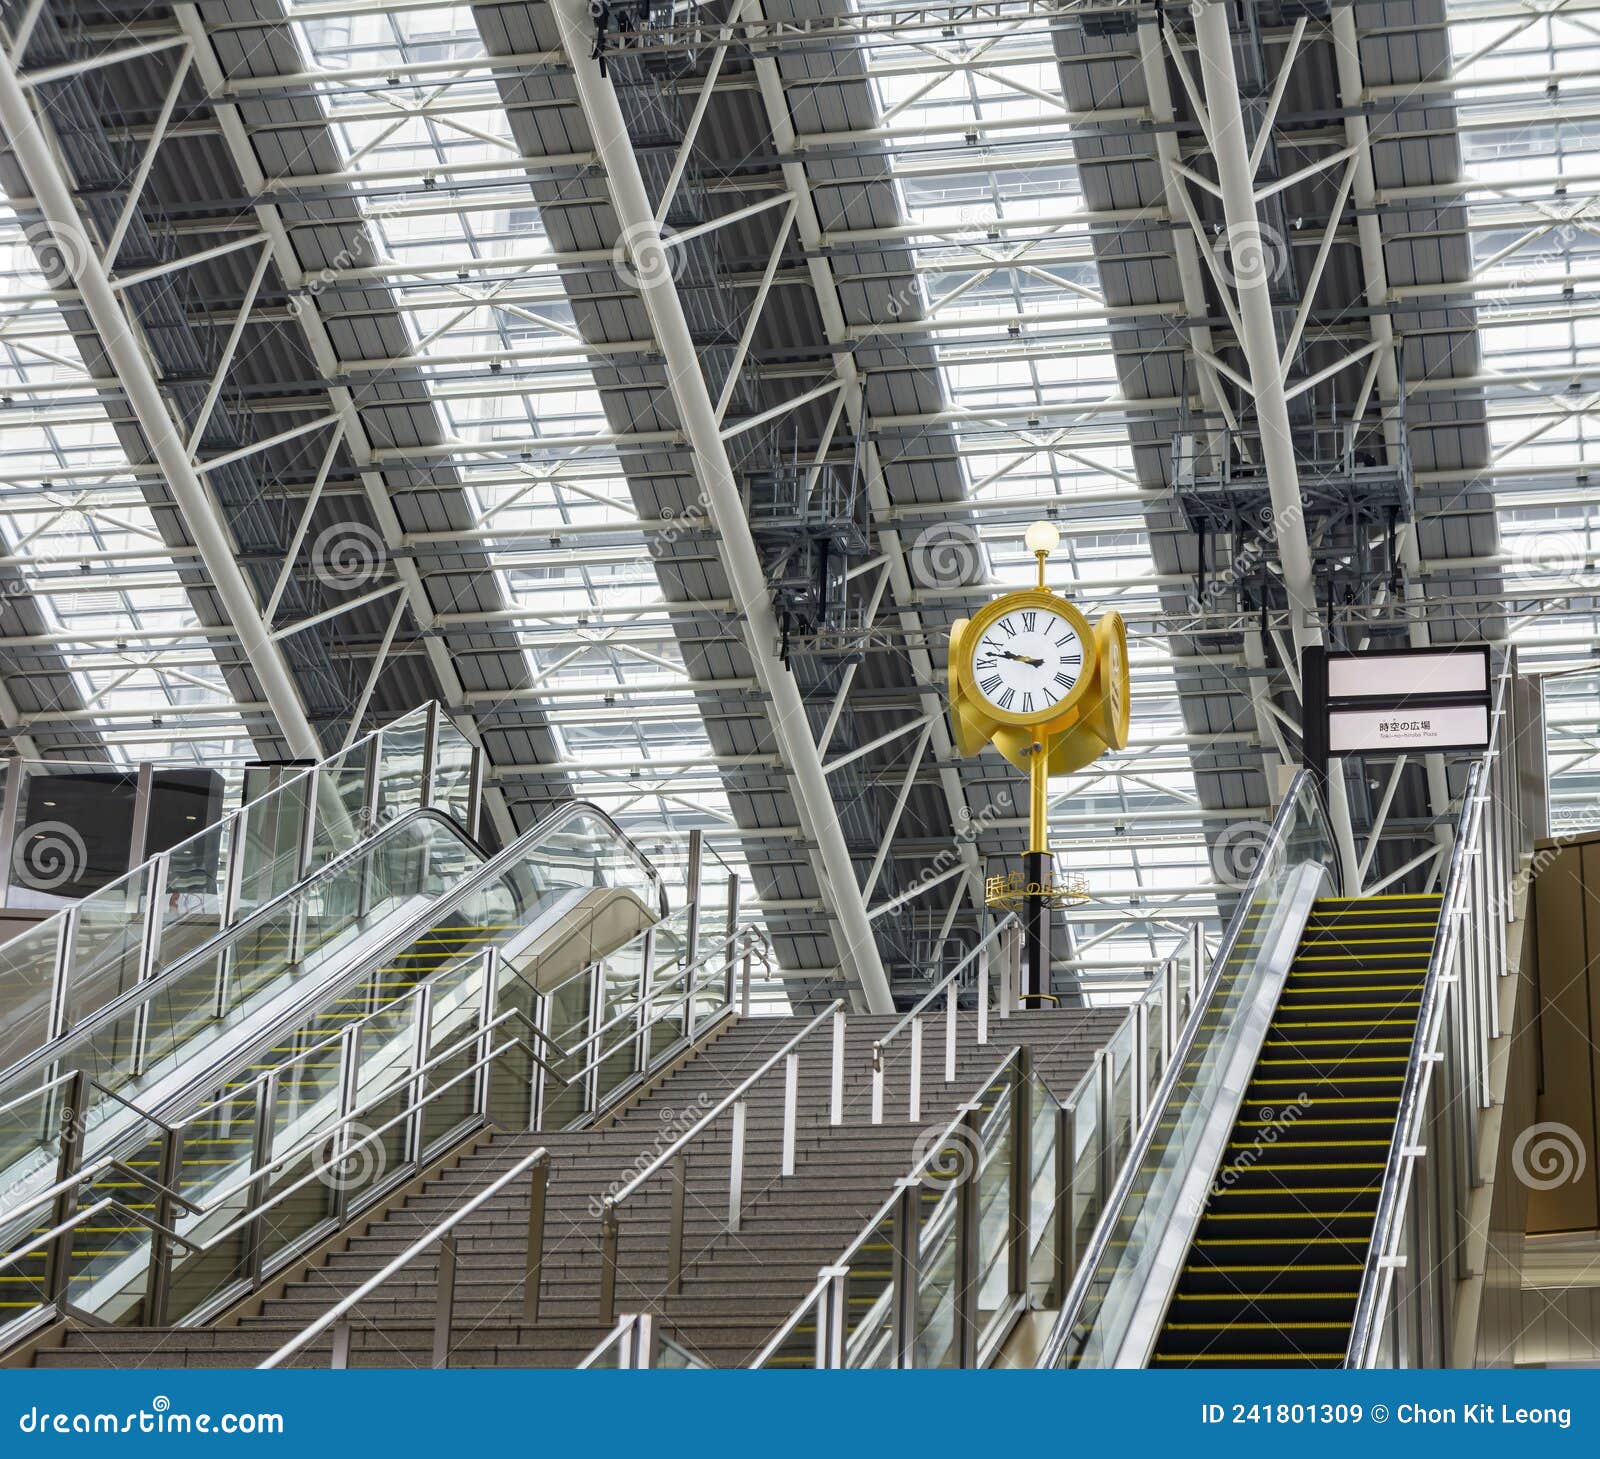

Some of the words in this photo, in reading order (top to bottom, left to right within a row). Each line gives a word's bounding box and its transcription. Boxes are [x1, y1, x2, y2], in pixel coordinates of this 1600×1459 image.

[998, 618, 1016, 639] XI
[1022, 612, 1036, 632] XII
[982, 636, 1004, 651] X
[1379, 720, 1431, 732] 時空の広場
